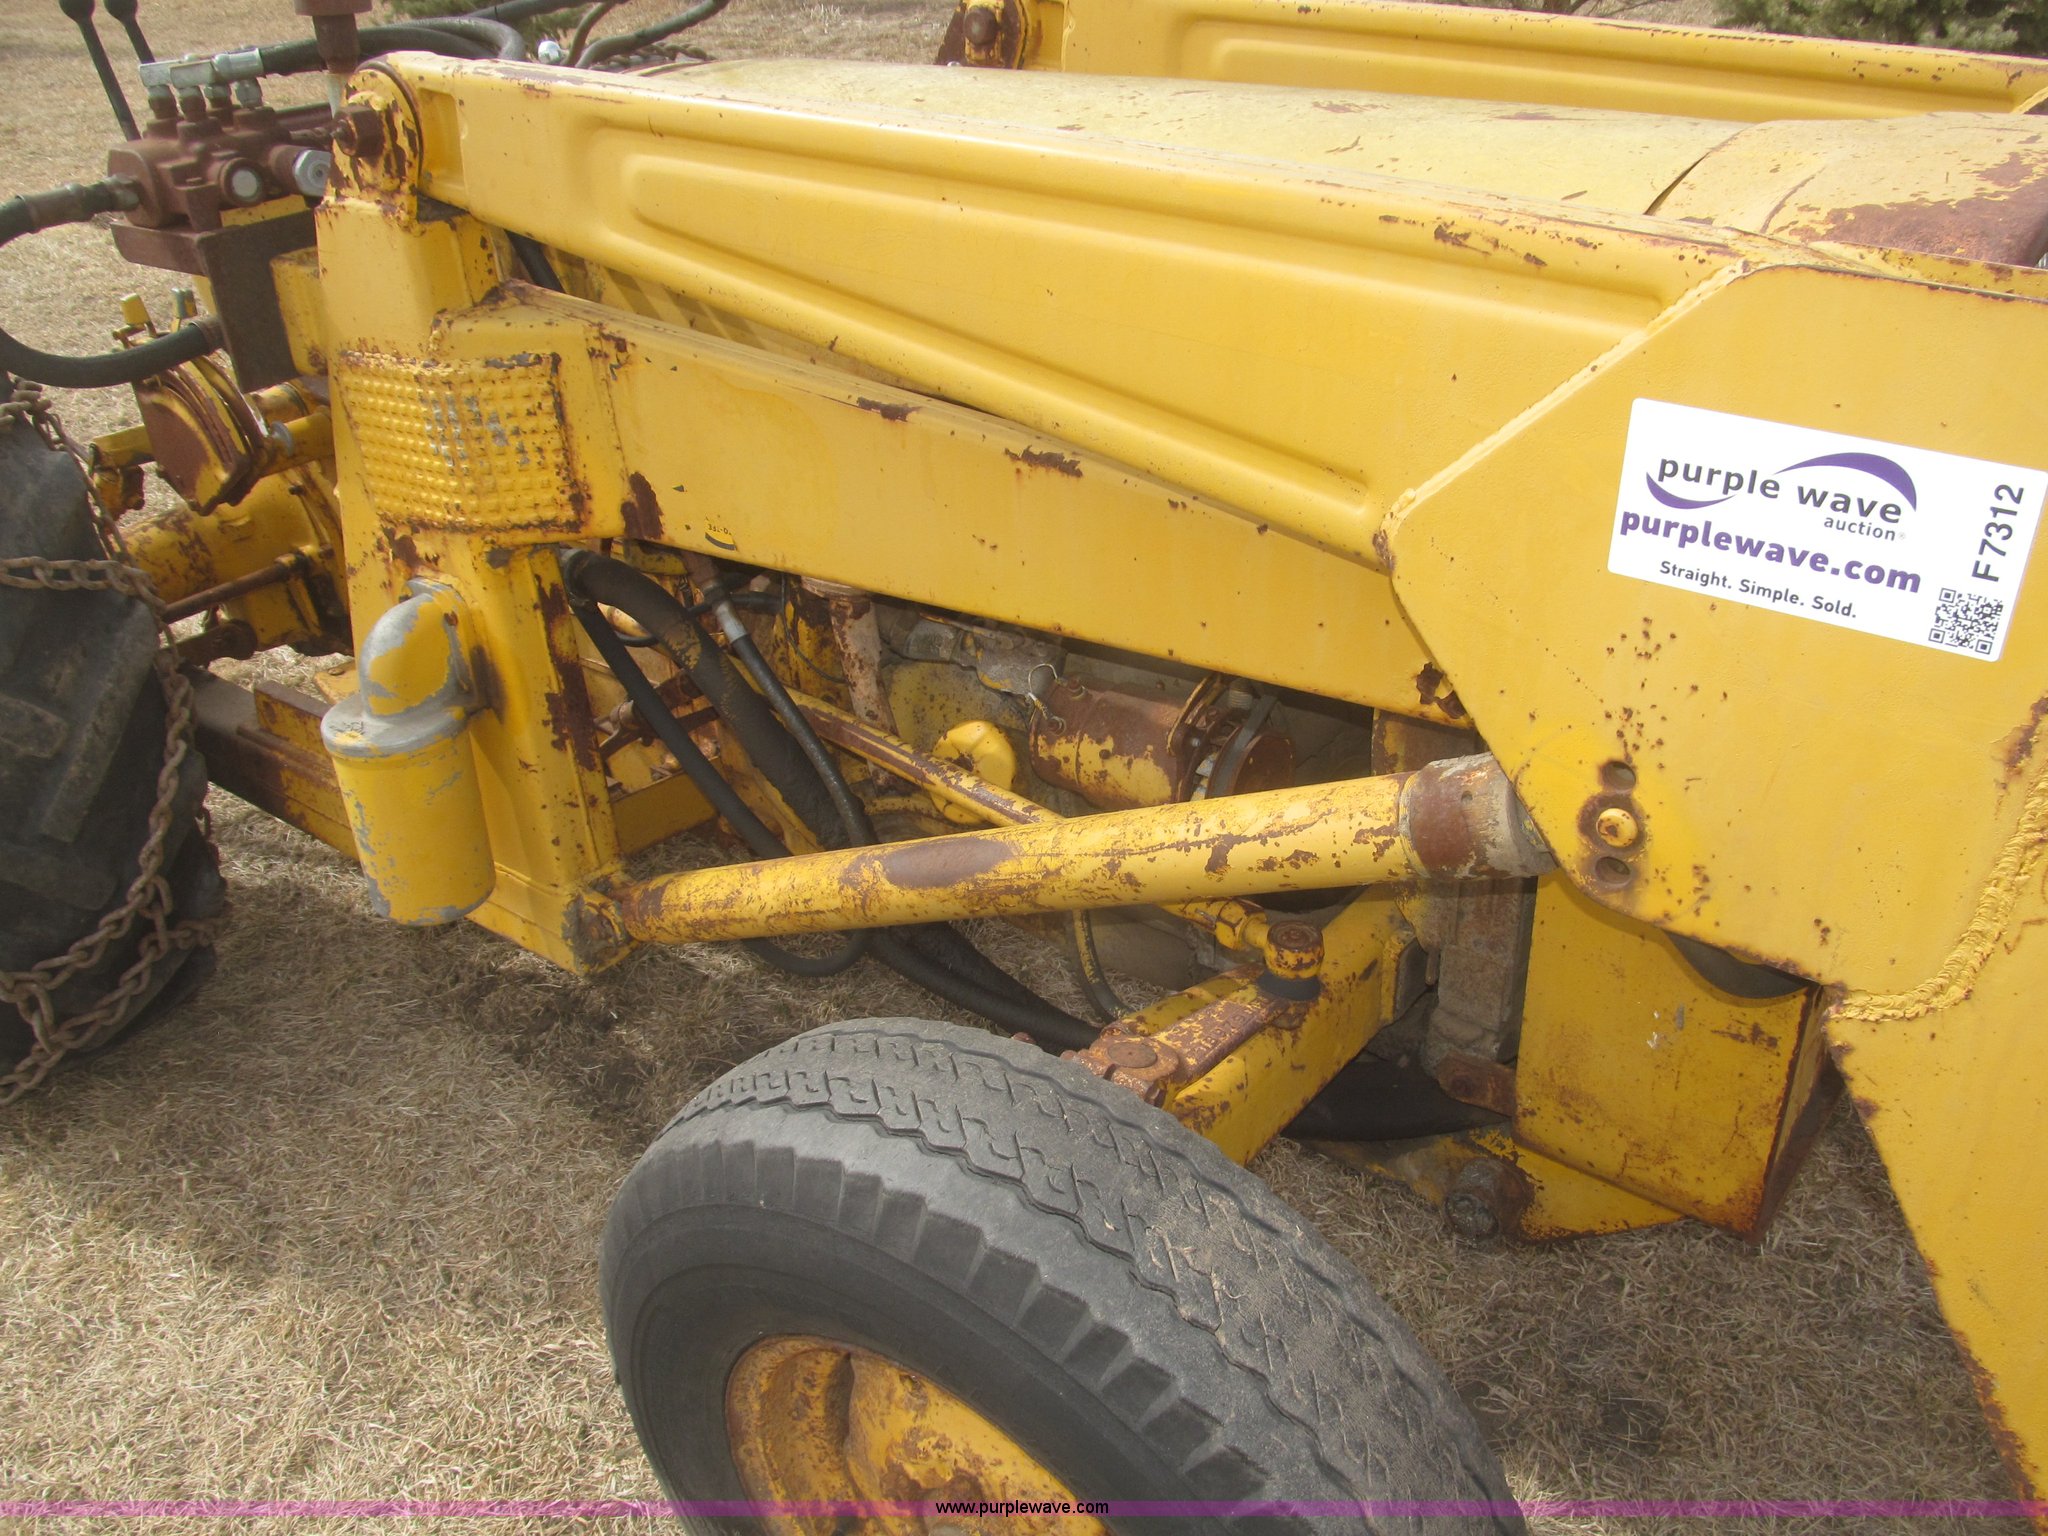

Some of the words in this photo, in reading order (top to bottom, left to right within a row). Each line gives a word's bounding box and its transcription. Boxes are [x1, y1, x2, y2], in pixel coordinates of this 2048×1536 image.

[1657, 457, 1781, 499] purple
[1797, 485, 1902, 524] wave
[1620, 510, 1921, 593] purplewave.com
[1972, 483, 2024, 582] F7312
[1659, 560, 1731, 590] Straight.
[1738, 578, 1804, 607] Simple.
[1811, 595, 1857, 619] Sold.
